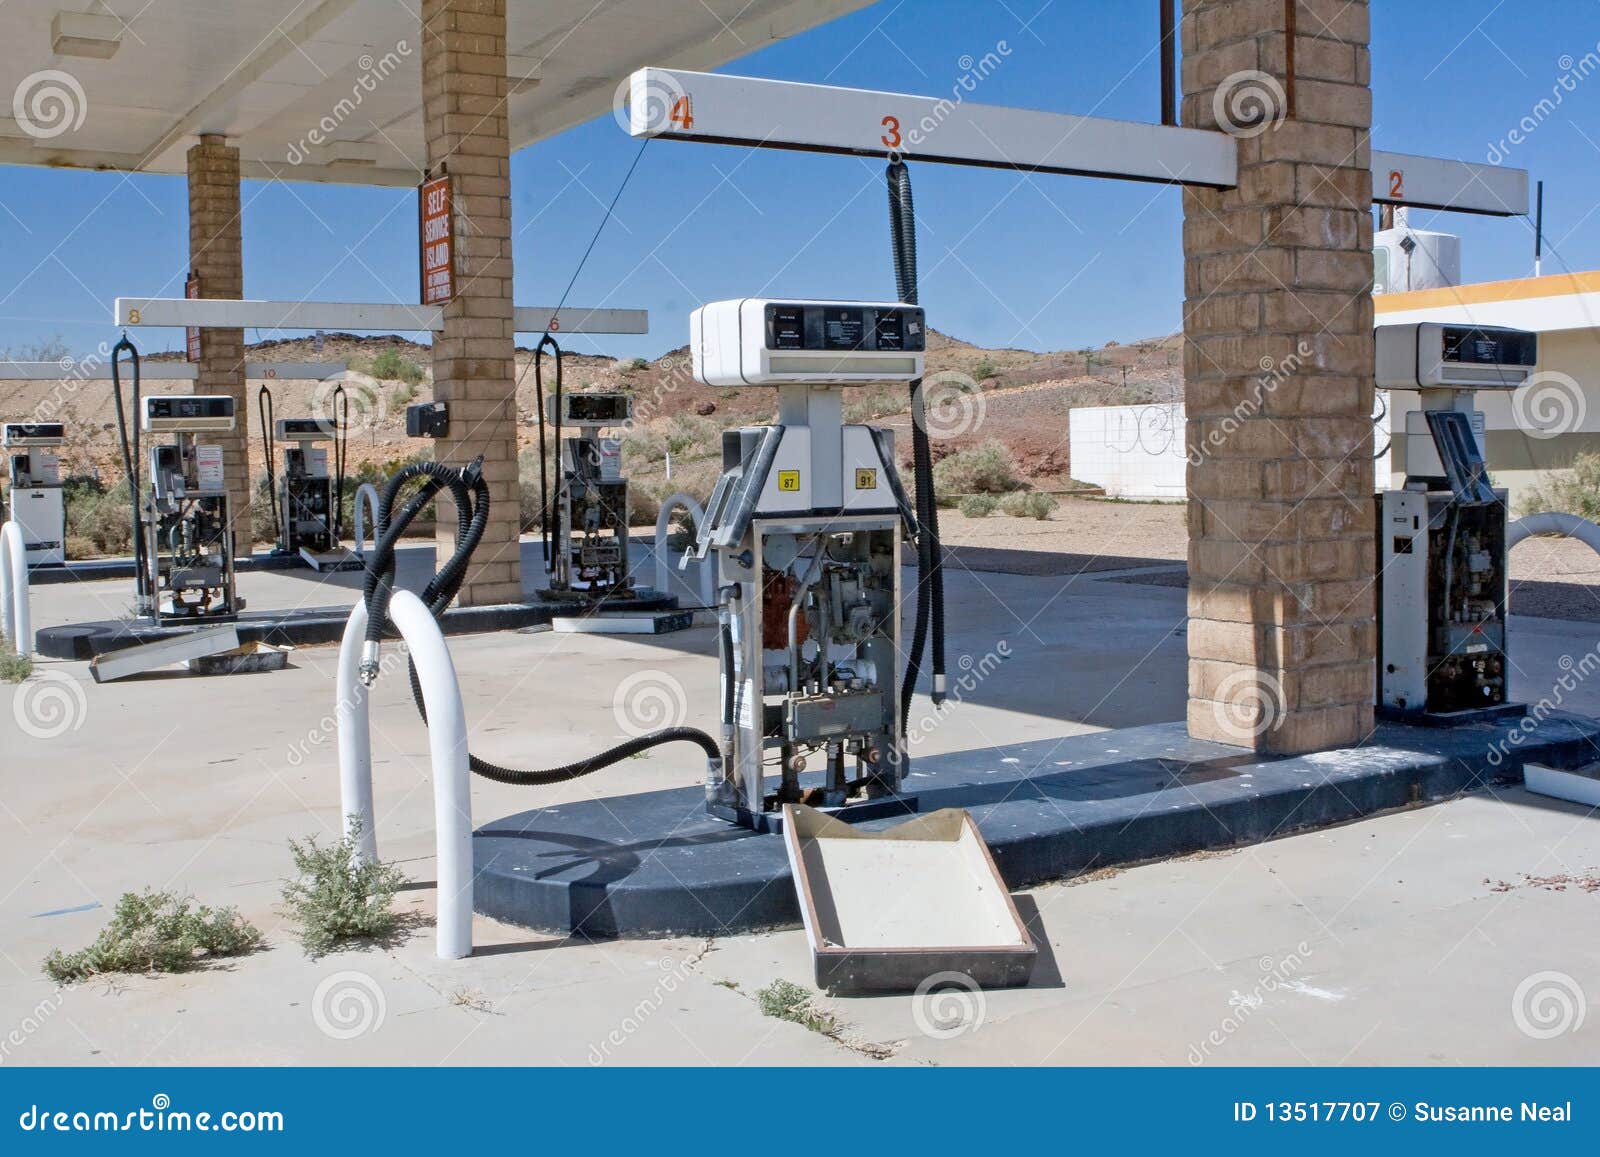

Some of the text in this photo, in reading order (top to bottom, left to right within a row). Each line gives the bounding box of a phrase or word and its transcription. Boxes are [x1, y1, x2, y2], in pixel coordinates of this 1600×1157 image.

[670, 95, 693, 129] 4
[881, 115, 901, 148] 3
[1390, 171, 1404, 198] 2
[428, 187, 447, 216] SELF
[426, 242, 449, 270] ISLAND
[129, 309, 140, 324] 8
[550, 318, 559, 331] 6
[263, 369, 276, 378] 10
[784, 479, 794, 488] 87
[861, 476, 872, 487] 91
